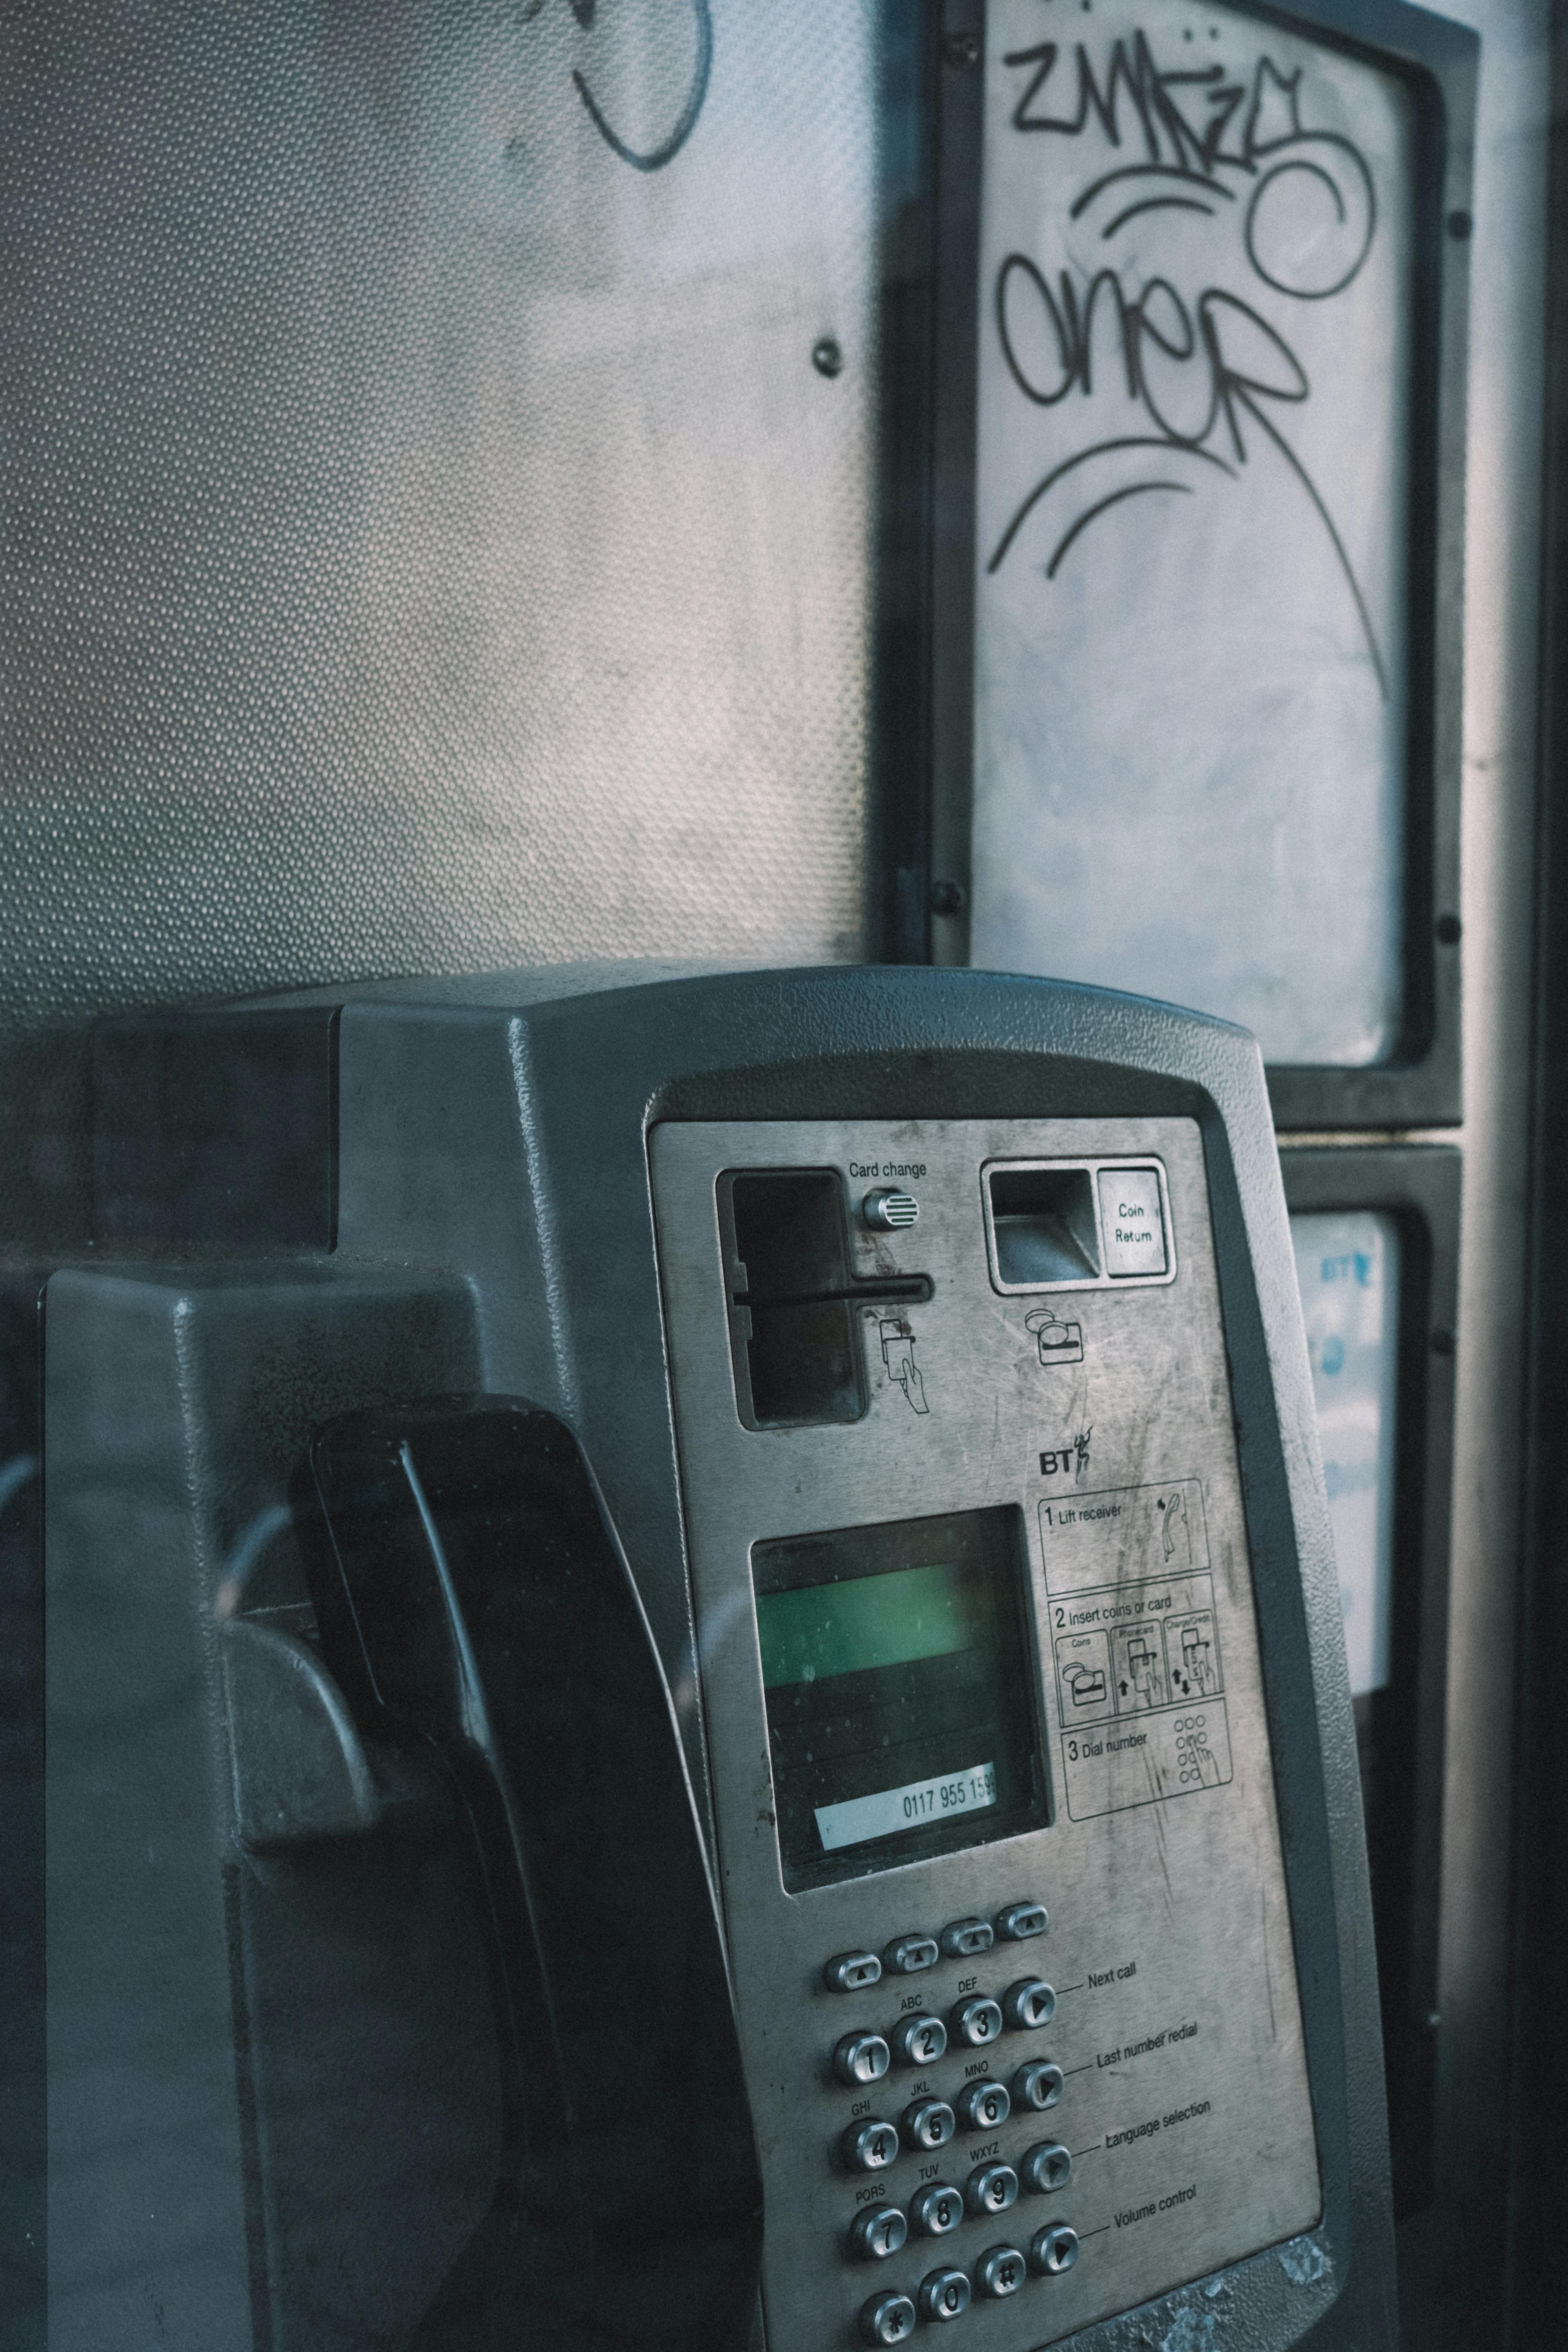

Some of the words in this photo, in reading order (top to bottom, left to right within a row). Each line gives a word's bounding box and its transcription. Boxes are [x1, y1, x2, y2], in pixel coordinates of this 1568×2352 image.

[849, 1162, 879, 1177] Card
[882, 1162, 927, 1180] change
[1119, 1203, 1144, 1218] Coin
[1116, 1229, 1151, 1243] Return
[1039, 1449, 1074, 1475] BT
[1045, 1506, 1053, 1526] 1
[1058, 1508, 1077, 1525] Lift
[1079, 1505, 1122, 1520] receiver
[1056, 1608, 1066, 1628] 2
[1069, 1609, 1101, 1626] Insert
[1103, 1603, 1132, 1620] coins
[1134, 1602, 1146, 1614] or
[1147, 1595, 1171, 1611] card
[1072, 1638, 1090, 1647] Coins
[1119, 1625, 1154, 1637] Phonecard
[1069, 1740, 1078, 1761] 3
[1082, 1741, 1103, 1758] Dial
[1106, 1733, 1147, 1753] number
[903, 1790, 933, 1818] 0117
[940, 1782, 965, 1808] 955
[958, 1977, 978, 1993] DEF
[1088, 1969, 1114, 1989] Next
[1117, 1961, 1136, 1979] call
[901, 1995, 922, 2011] ABC
[977, 2011, 988, 2037] 3
[920, 2029, 934, 2056] 2
[1097, 2048, 1121, 2068] Last
[1123, 2033, 1165, 2059] number
[1168, 2022, 1197, 2044] redial
[866, 2047, 873, 2074] 1
[965, 2060, 989, 2078] MNO
[910, 2081, 930, 2097] JKL
[851, 2099, 870, 2116] GHI
[985, 2095, 997, 2121] 6
[929, 2114, 942, 2141] 5
[1106, 2120, 1159, 2148] Language
[1163, 2101, 1211, 2127] selection
[872, 2133, 886, 2160] 4
[970, 2142, 1000, 2162] WXYZ
[918, 2164, 940, 2180] TUV
[855, 2183, 886, 2204] PQRS
[992, 2178, 1005, 2204] 9
[937, 2199, 950, 2227] 8
[1114, 2203, 1156, 2228] Volume
[1159, 2184, 1197, 2210] control
[881, 2221, 893, 2250] 7
[944, 2285, 958, 2311] 0
